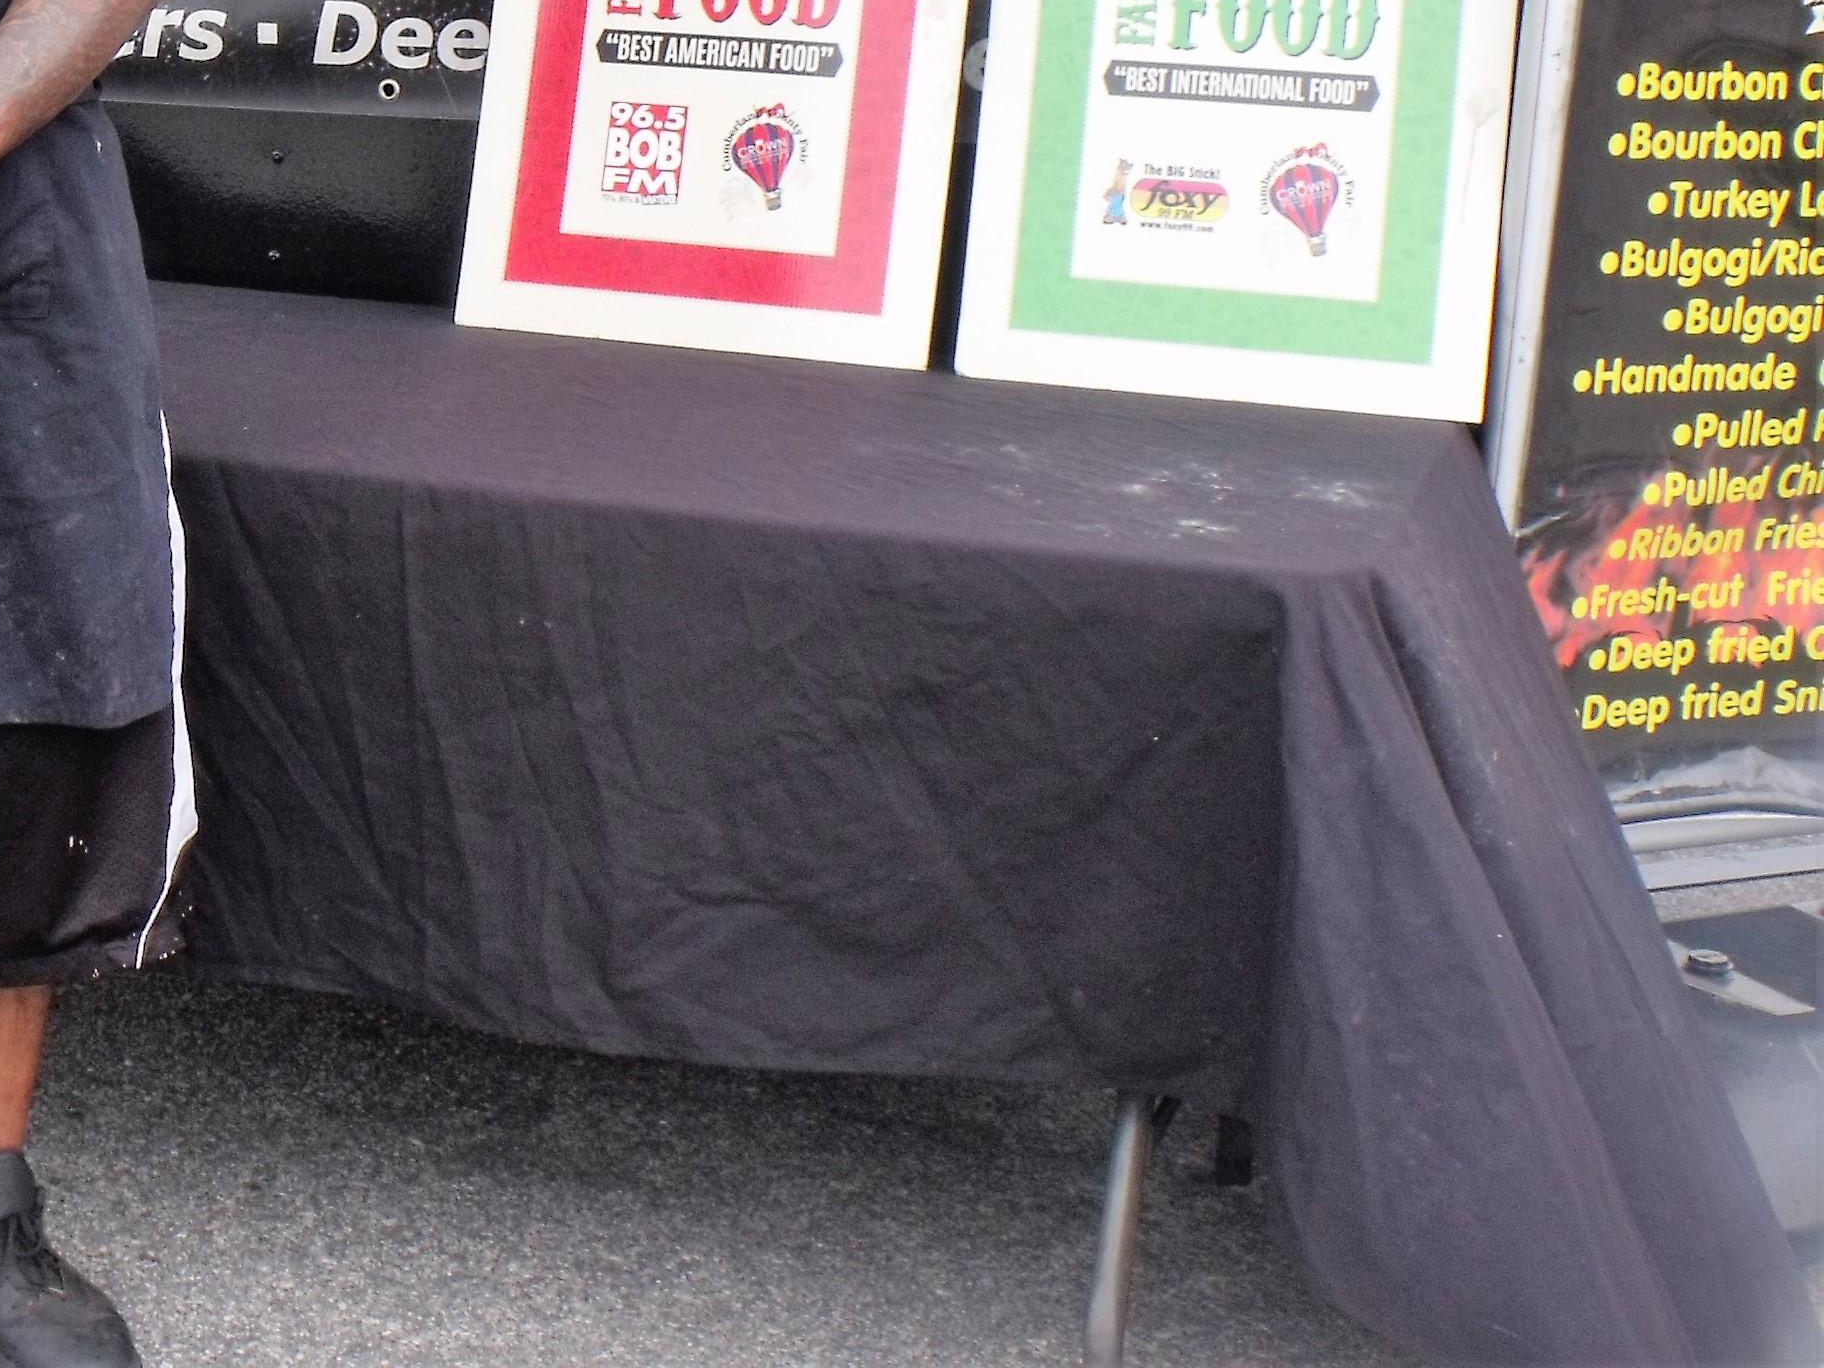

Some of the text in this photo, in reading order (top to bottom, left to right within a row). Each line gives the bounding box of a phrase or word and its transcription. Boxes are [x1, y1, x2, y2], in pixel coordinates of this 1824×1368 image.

[665, 36, 765, 70] AMERICAN
[1170, 68, 1305, 102] INTERNATIONAL
[610, 102, 686, 131] 96.5
[606, 127, 682, 171] BOB
[602, 166, 678, 195] FM
[1144, 163, 1163, 176] The
[1139, 180, 1224, 216] foxy
[1707, 625, 1796, 665] fried
[1581, 693, 1671, 734] Deep
[1680, 679, 1766, 721] fried
